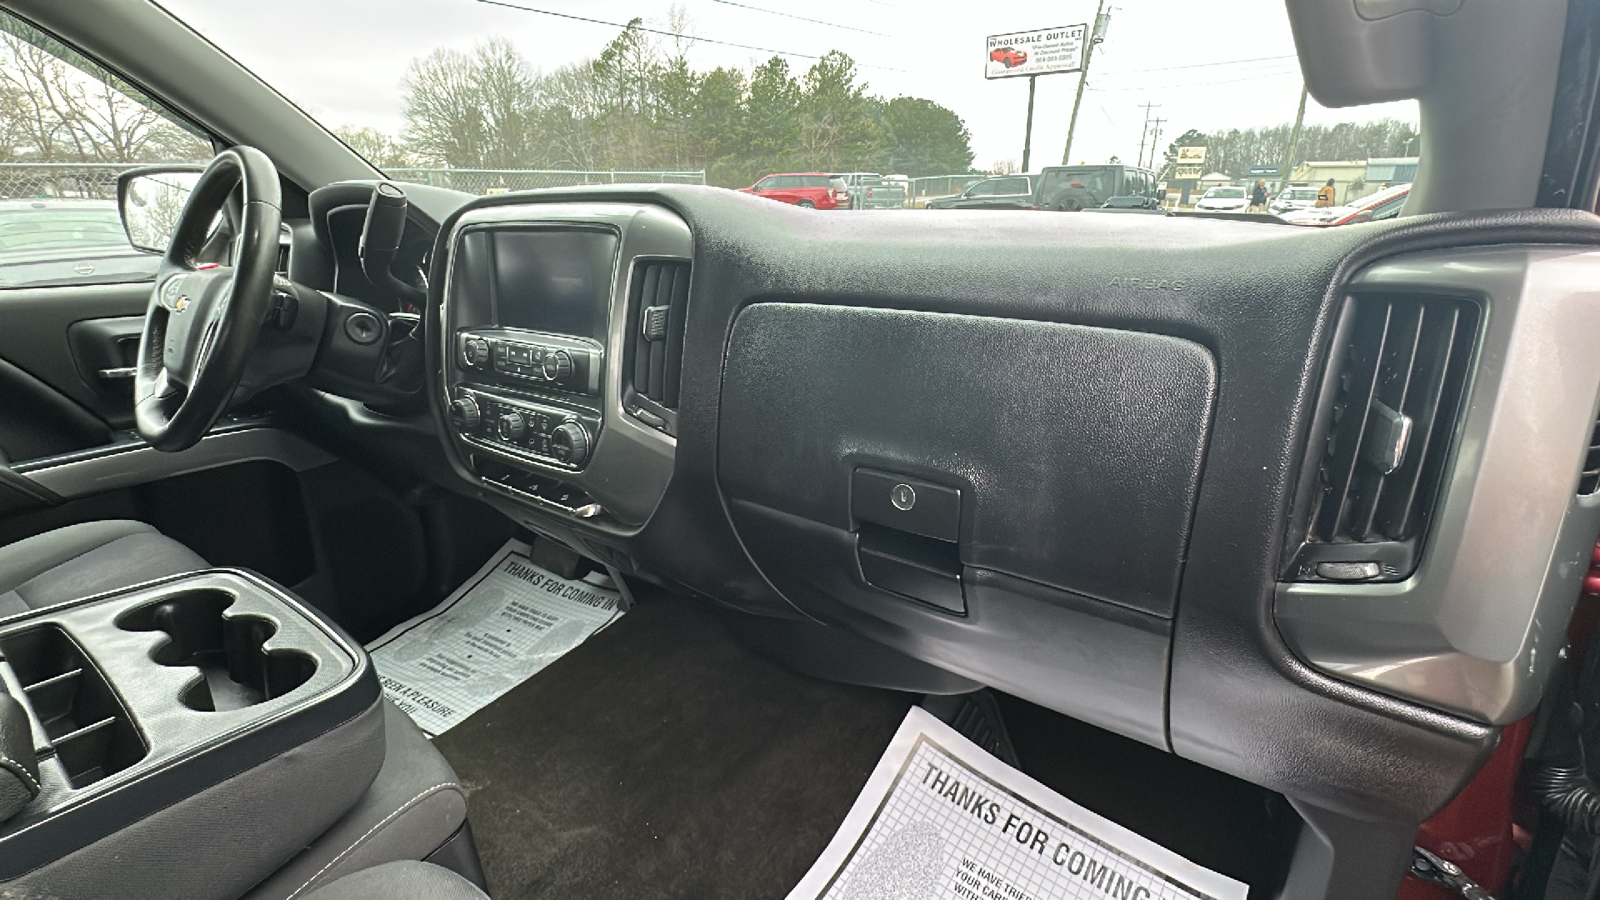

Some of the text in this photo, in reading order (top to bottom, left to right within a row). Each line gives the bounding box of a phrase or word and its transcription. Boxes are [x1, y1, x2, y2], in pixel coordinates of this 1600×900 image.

[990, 30, 1082, 47] WHOLESALE OUTLET
[1106, 276, 1185, 292] AIRBAG
[503, 561, 618, 611] THANKS FOR COMING IN
[407, 690, 456, 718] PLEASURE
[922, 762, 1151, 900] THANKS FOR COMING
[955, 867, 981, 890] YOUR
[962, 858, 977, 872] WE
[977, 867, 1002, 889] HAVE
